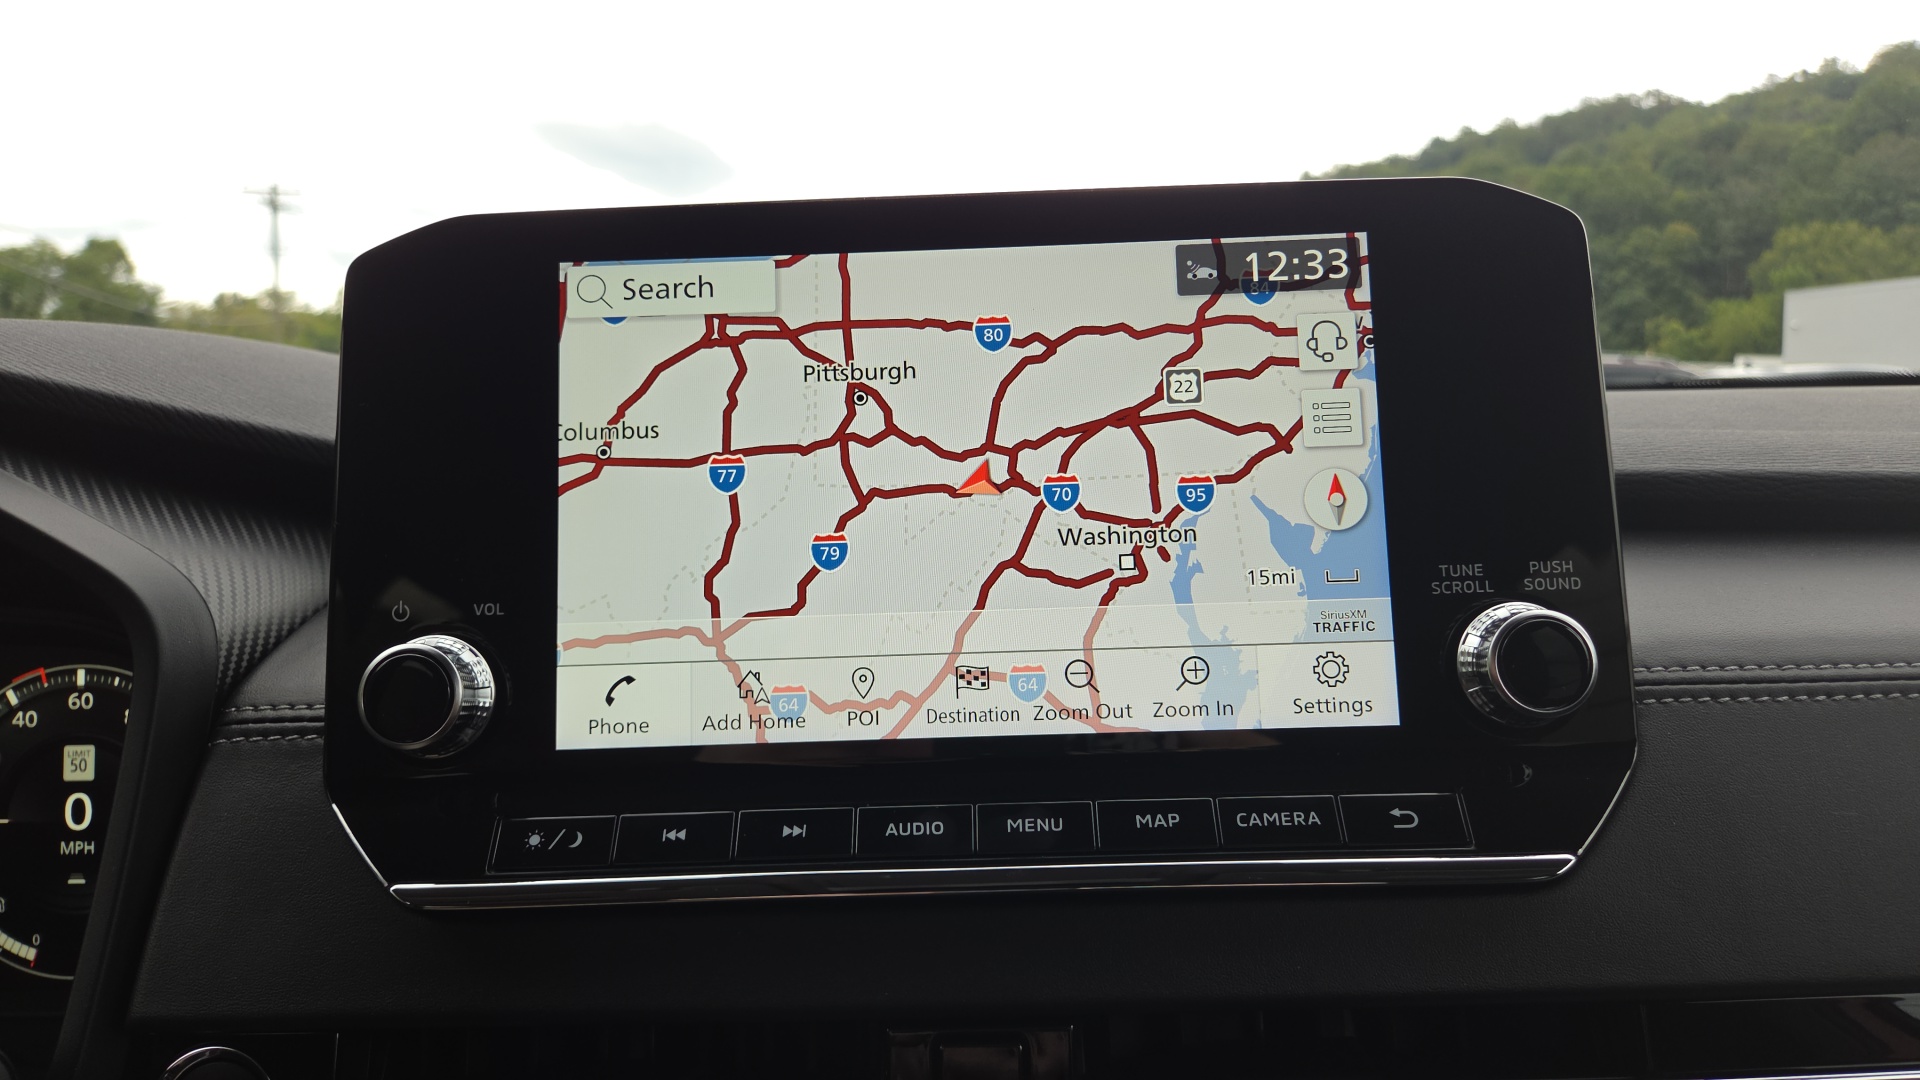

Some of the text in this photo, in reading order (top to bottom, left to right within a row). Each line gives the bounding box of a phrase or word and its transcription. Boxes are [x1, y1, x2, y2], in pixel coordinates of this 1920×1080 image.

[1245, 248, 1349, 282] 12:33
[622, 275, 714, 301] Search
[983, 327, 1003, 343] 80
[803, 361, 917, 385] Pittsburgh
[1174, 379, 1194, 394] 22
[717, 469, 738, 484] 77
[1051, 487, 1072, 502] 70
[1186, 487, 1206, 502] 95
[1057, 525, 1198, 549] Washington
[820, 546, 840, 562] 79
[1439, 563, 1484, 577] TUNE
[1529, 560, 1574, 574] PUSH
[1247, 568, 1296, 587] 15mi
[1524, 577, 1582, 591] SOUND
[1431, 581, 1495, 594] SCROLL
[474, 603, 504, 615] VOL
[1320, 609, 1368, 621] SiriusXM
[1313, 620, 1376, 634] TRAFFIC
[1017, 677, 1038, 692] 64
[67, 692, 94, 710] 60
[778, 697, 799, 713] 64
[1152, 700, 1235, 718] Zoom In
[1293, 696, 1374, 717] Settings
[12, 710, 38, 728] 40
[847, 710, 880, 726] POI
[927, 706, 1020, 724] Destination
[1033, 702, 1133, 721] Zoom Out
[588, 718, 650, 735] Phone
[702, 713, 806, 731] Add Home
[67, 750, 91, 759] LIMIT
[70, 758, 88, 773] 50
[64, 792, 93, 831] 0
[1236, 811, 1322, 828] CAMERA
[885, 821, 944, 837] AUDIO
[1007, 817, 1063, 832] MENU
[1135, 813, 1180, 829] MAP
[60, 841, 95, 855] MPH
[32, 933, 40, 946] 0
